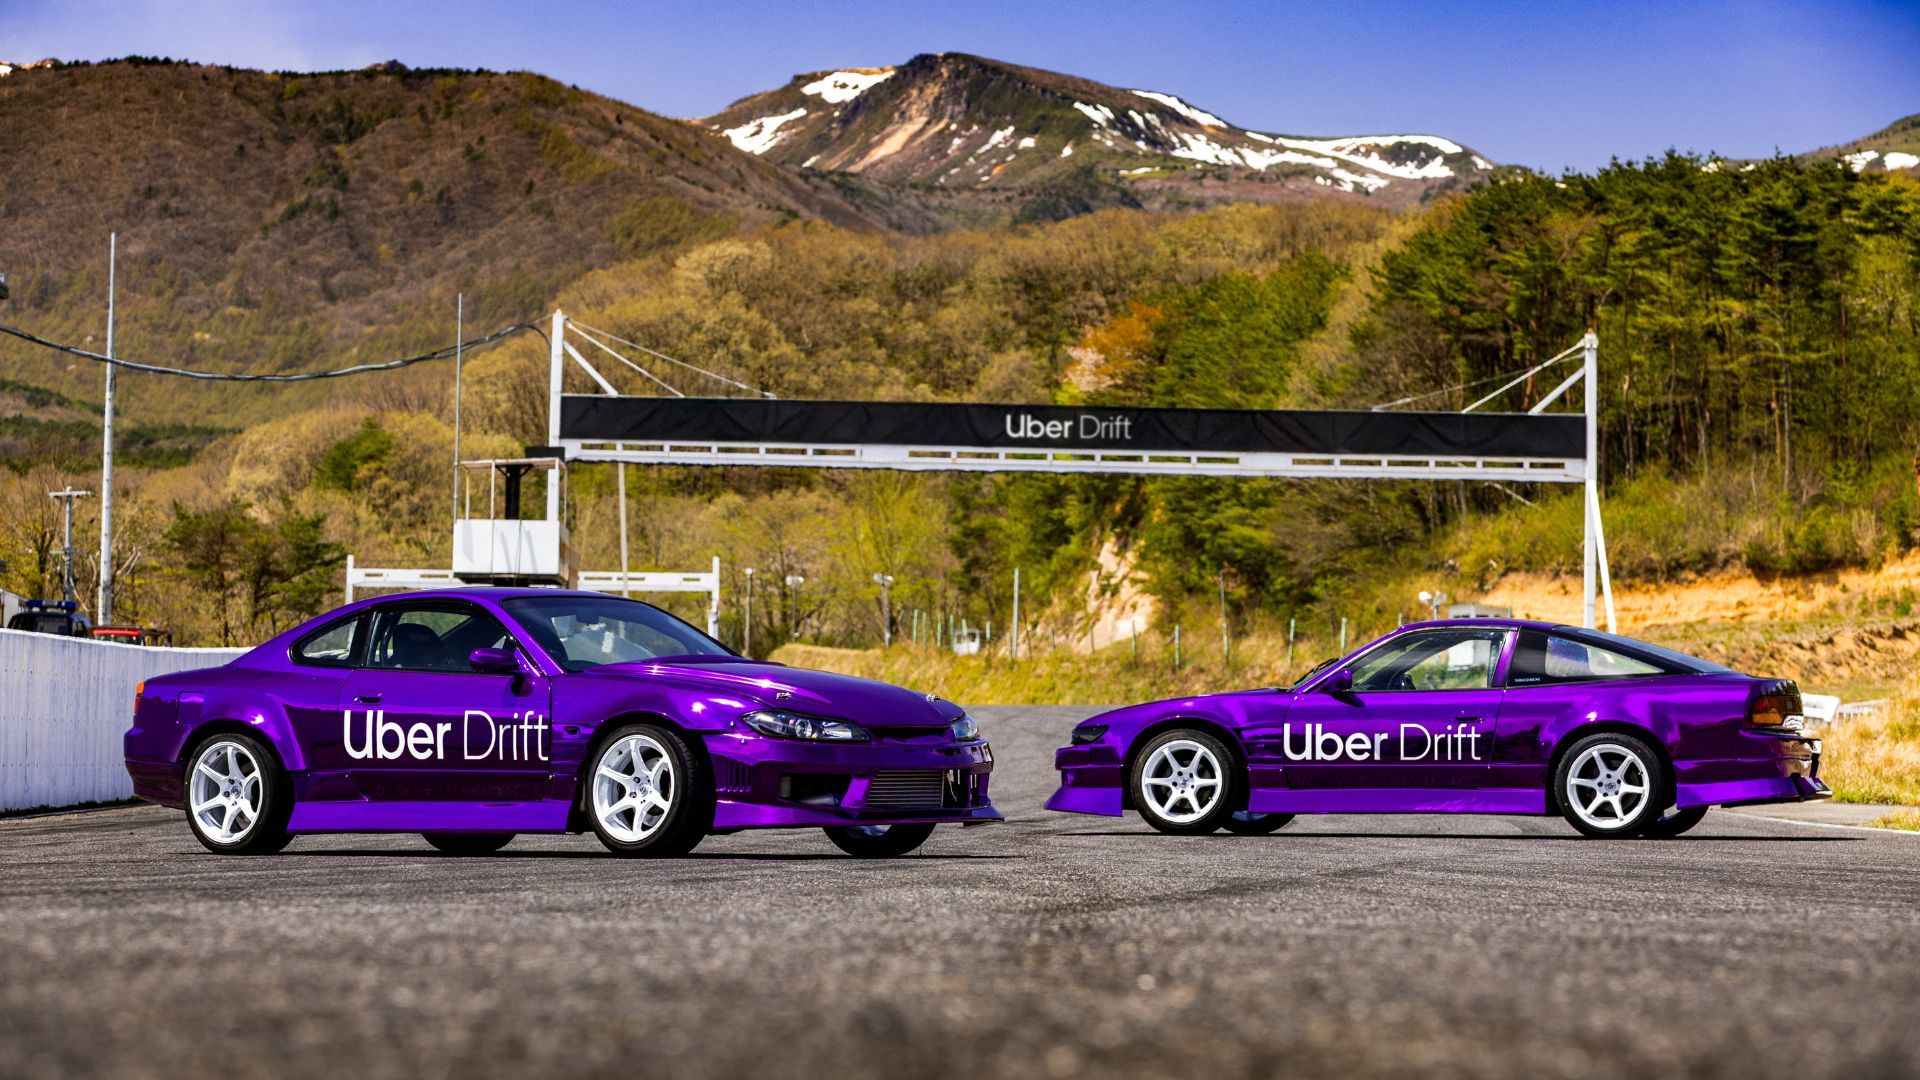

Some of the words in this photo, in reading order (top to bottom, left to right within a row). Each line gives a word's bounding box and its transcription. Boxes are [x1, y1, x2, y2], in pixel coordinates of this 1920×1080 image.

[1005, 414, 1073, 439] Uber
[1079, 415, 1132, 440] Drift
[343, 709, 452, 760] Uber
[463, 710, 549, 761] Drift
[1283, 723, 1389, 761] Uber
[1399, 723, 1482, 761] Drift
